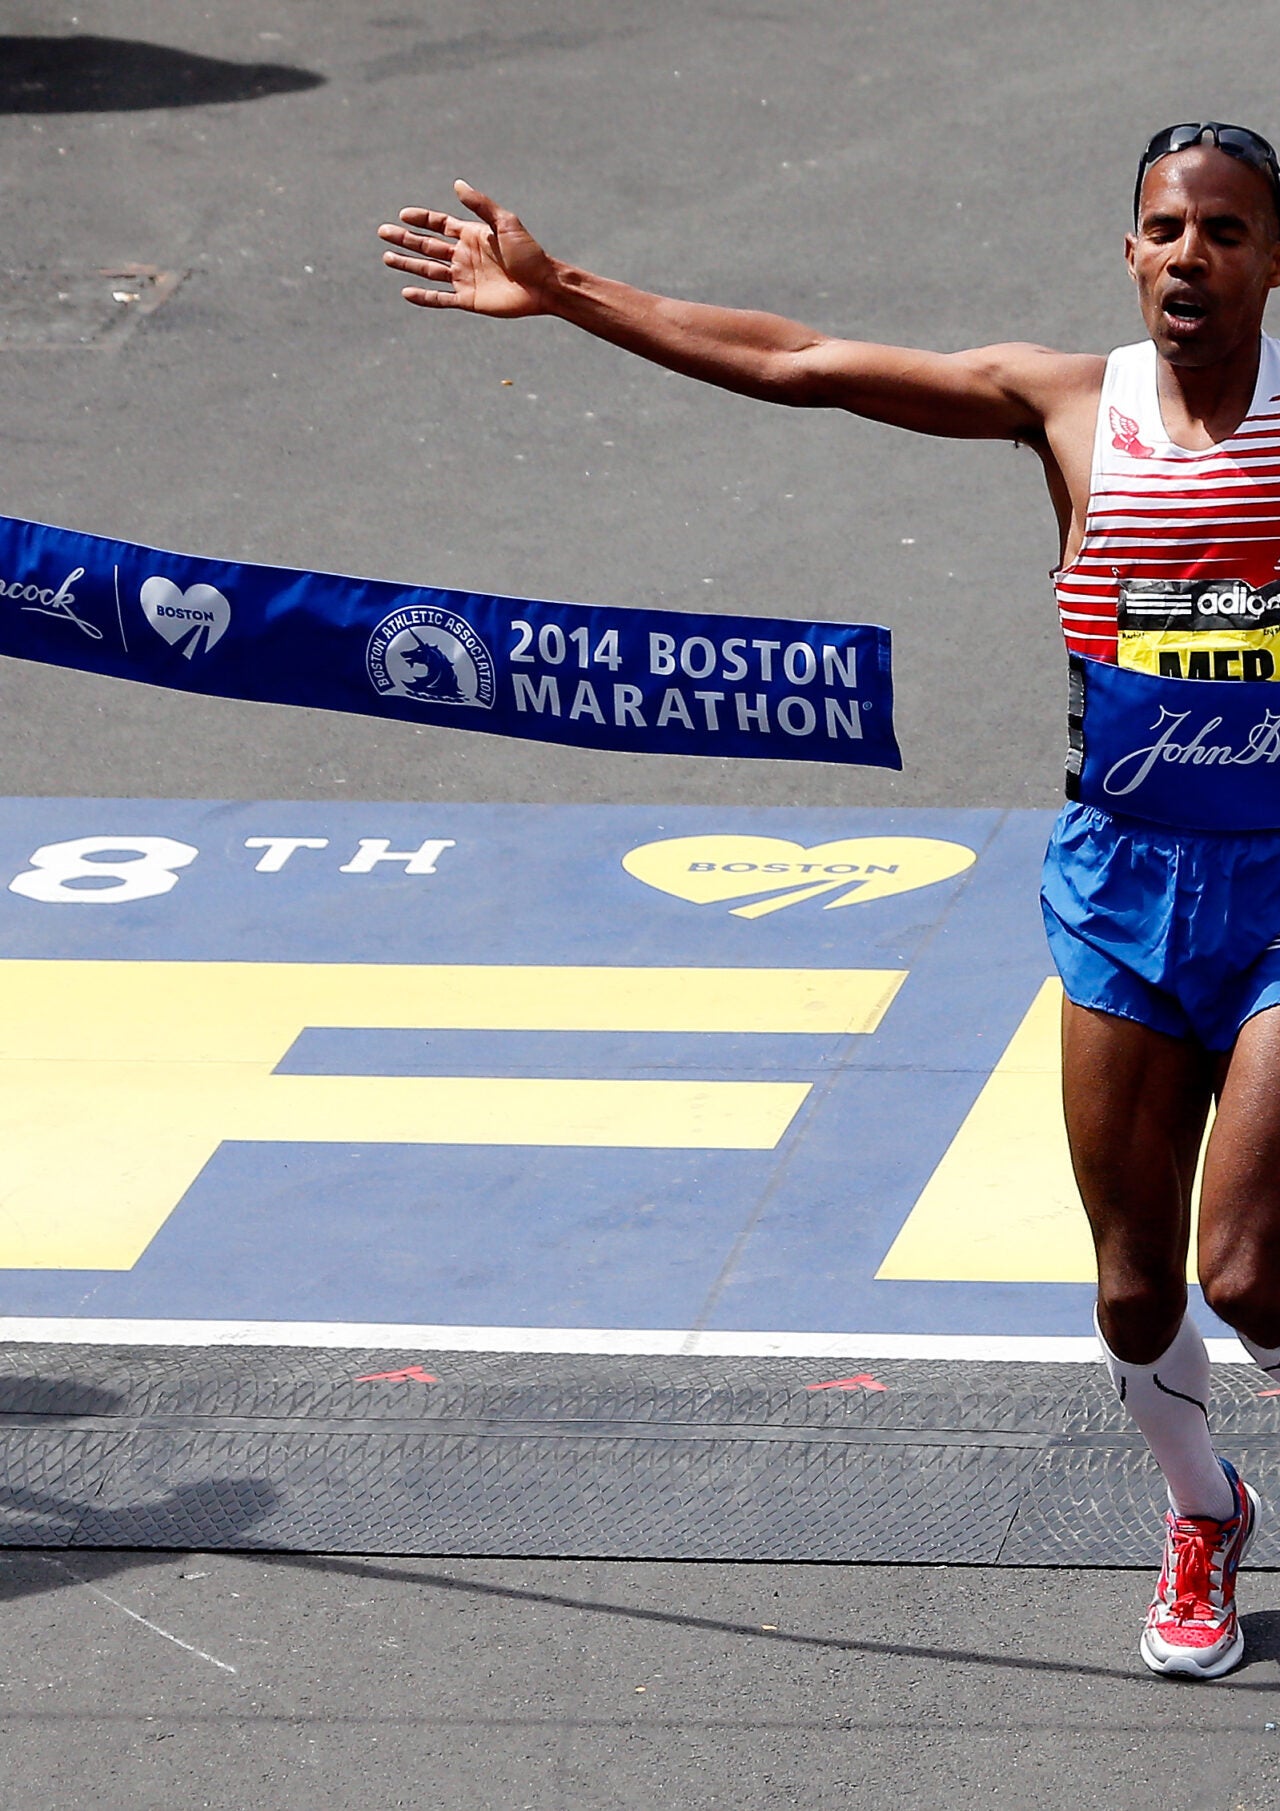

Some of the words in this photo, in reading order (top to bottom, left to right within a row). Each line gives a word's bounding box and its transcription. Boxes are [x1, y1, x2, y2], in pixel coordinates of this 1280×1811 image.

[157, 605, 214, 623] BOSTON
[371, 637, 390, 687] BOSTON
[381, 610, 443, 639] ATHLETIC
[444, 617, 491, 702] ASSOCIATION
[510, 620, 623, 672] 2014
[650, 632, 858, 689] BOSTON
[511, 673, 864, 740] MARATHON
[1102, 705, 1234, 796] John
[687, 862, 900, 875] BOSTON
